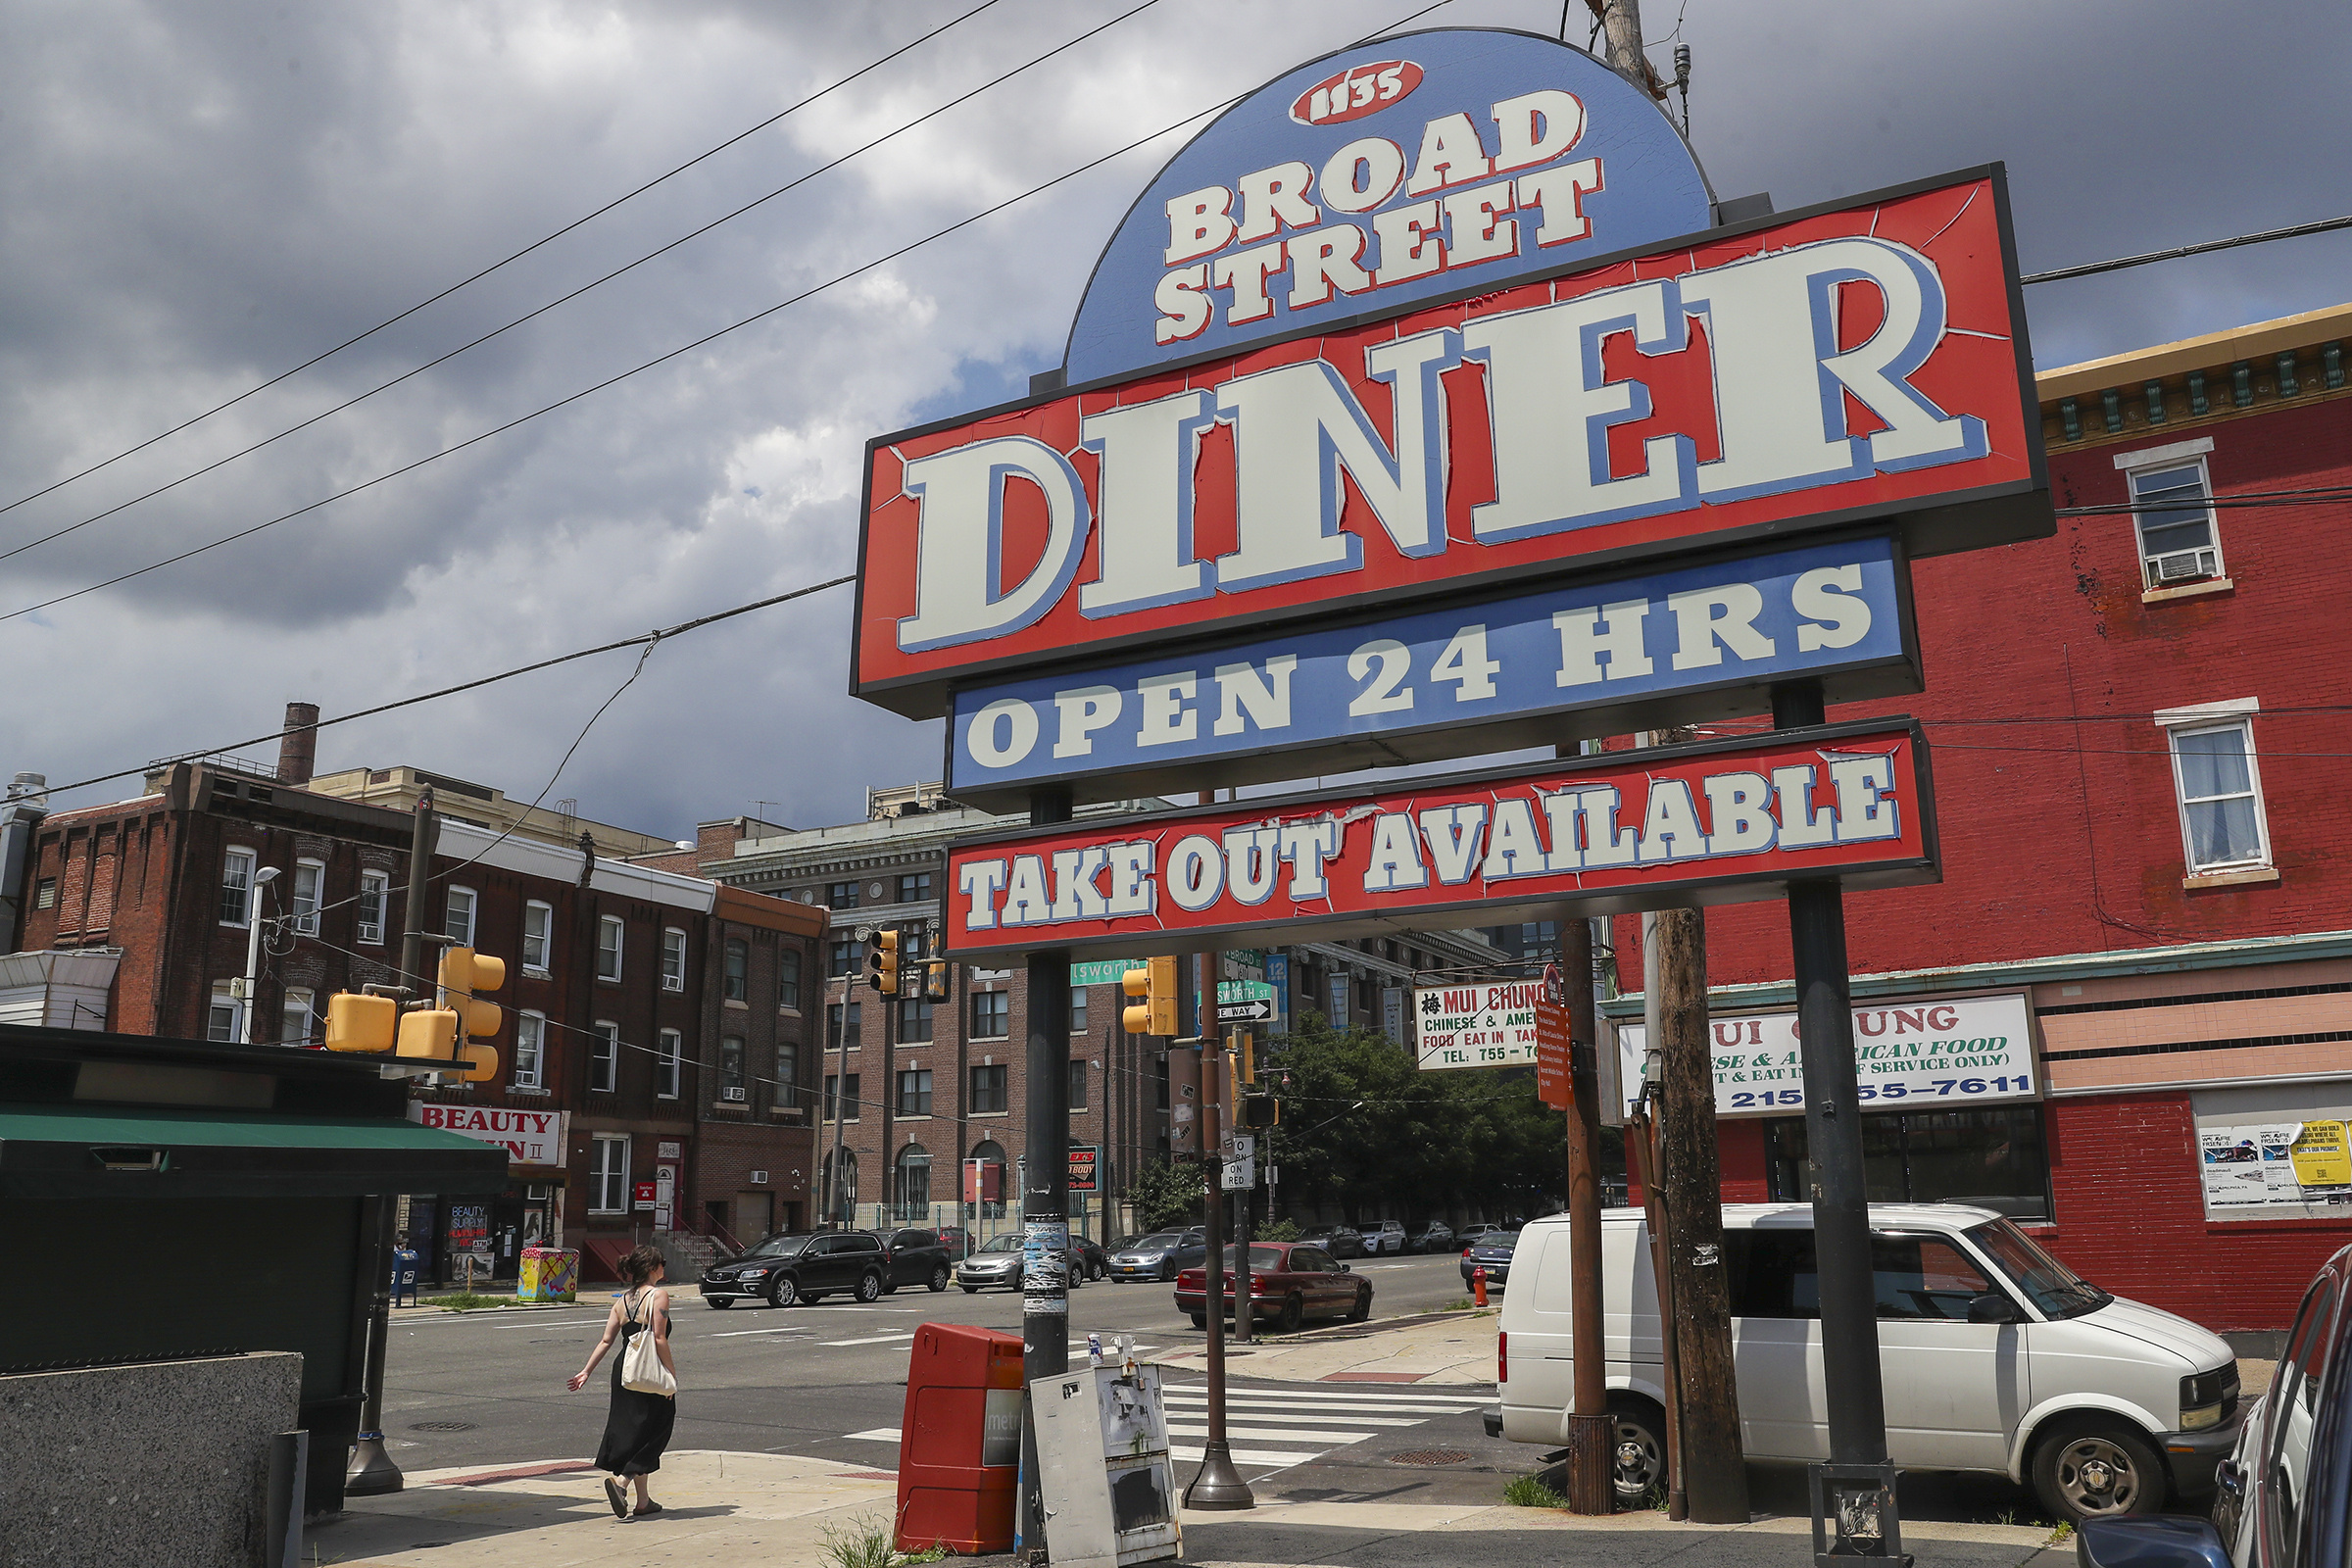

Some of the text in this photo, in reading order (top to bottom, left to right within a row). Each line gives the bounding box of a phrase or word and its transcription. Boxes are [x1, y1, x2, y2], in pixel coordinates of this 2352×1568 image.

[1309, 65, 1403, 123] 1135
[1164, 89, 1588, 268] BROAD
[1154, 157, 1604, 346] STREET
[896, 235, 1990, 654] DINER
[966, 563, 1872, 768] OPEN 24 HRS
[958, 754, 1902, 932] TAKE OUT AVAILABLE
[1230, 949, 1262, 967] BROAD ST
[1225, 962, 1231, 971] S
[1256, 972, 1262, 981] N
[1268, 962, 1285, 976] 12
[1258, 988, 1269, 998] ST
[1547, 979, 1556, 992] the
[1444, 989, 1478, 1014] MUI
[1549, 991, 1559, 1001] ave
[1217, 1006, 1251, 1017] NE WAY
[1425, 1016, 1478, 1032] CHINESE
[1486, 1014, 1497, 1028] &
[1423, 1034, 1455, 1049] FOOD
[1464, 1031, 1487, 1046] EAT
[1492, 1030, 1504, 1044] IN
[1712, 1020, 1763, 1047] UI
[1443, 1050, 1470, 1063] TEL:
[1479, 1047, 1505, 1061] 755
[1752, 1053, 1774, 1067] &
[1928, 1036, 2008, 1055] FOOD
[1732, 1071, 1747, 1083] &
[1751, 1067, 1786, 1081] EAT
[1870, 1058, 1950, 1074] SERVICE
[1955, 1052, 2010, 1068] ONLY)
[1731, 1089, 1803, 1108] 215
[422, 1107, 553, 1134] BEAUTY
[1230, 1165, 1243, 1174] ON
[1228, 1176, 1245, 1185] RED
[452, 1205, 485, 1217] BEAUTY
[452, 1216, 484, 1229] SUPPLY
